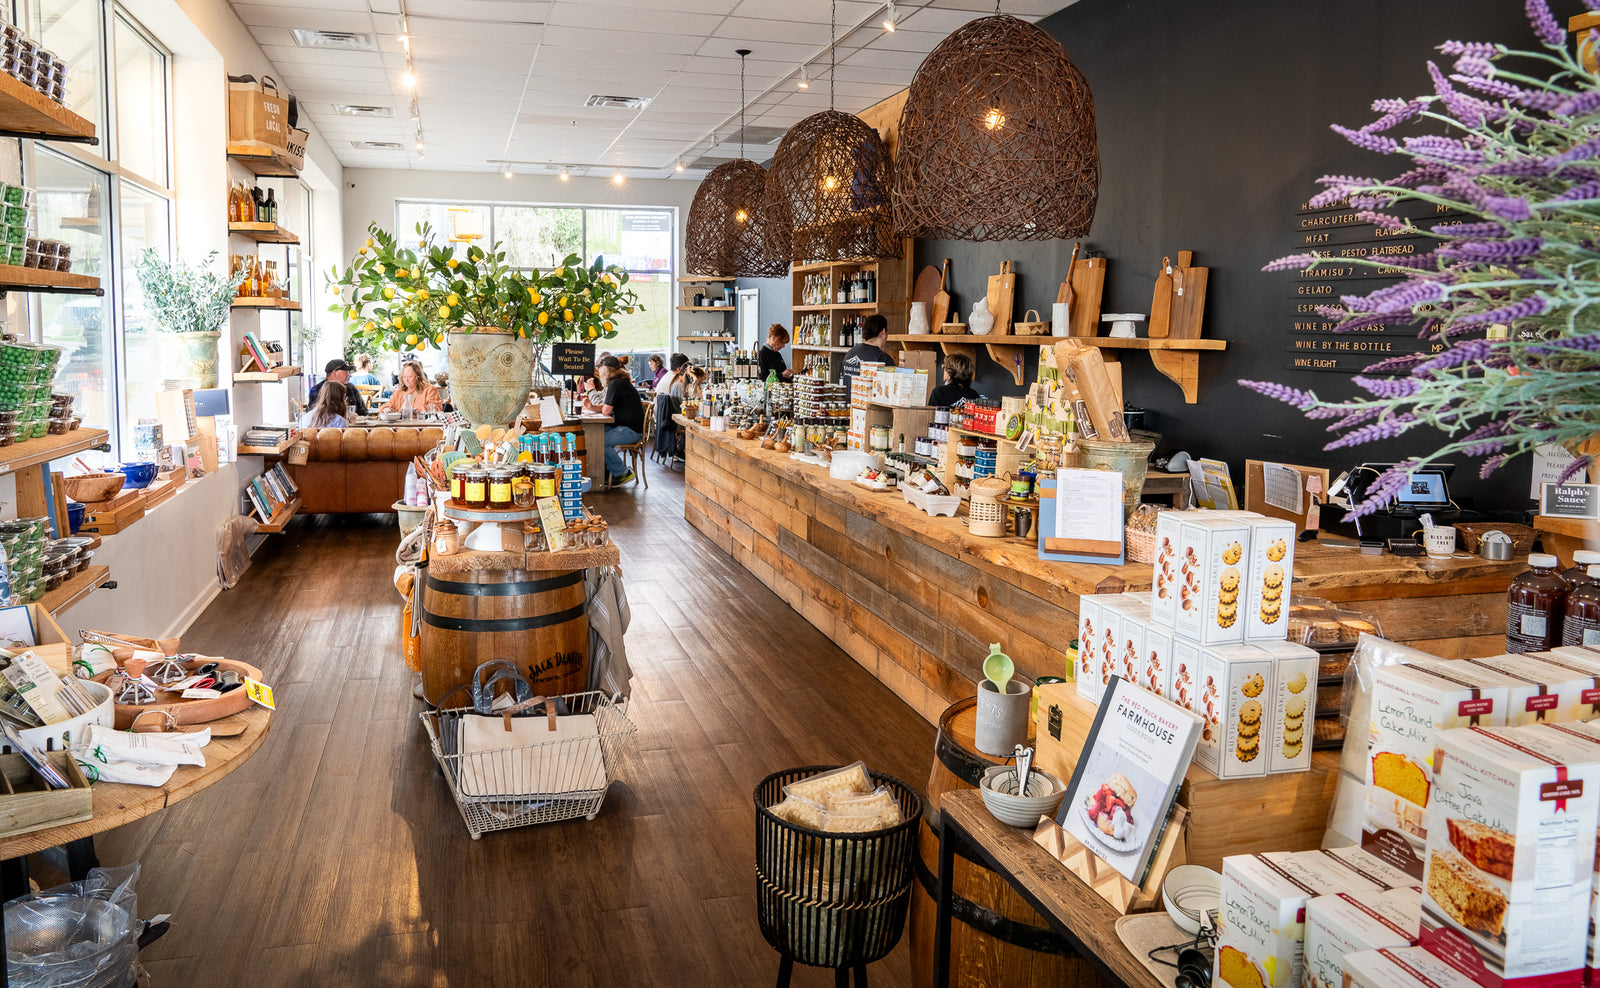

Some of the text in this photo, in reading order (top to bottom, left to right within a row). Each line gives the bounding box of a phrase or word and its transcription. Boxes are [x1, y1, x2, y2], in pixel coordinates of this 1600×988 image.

[263, 102, 280, 115] FRESH
[266, 120, 281, 133] LOCAL
[1342, 248, 1367, 257] PESTO
[1372, 245, 1414, 255] FLATBREAD
[1300, 269, 1344, 277] TIRAMISU
[1298, 286, 1332, 294] GELATO
[1296, 341, 1317, 349] WINE
[1335, 342, 1350, 350] THE
[1353, 343, 1392, 351] BOTTLE
[1294, 358, 1312, 367] WINE
[1555, 487, 1590, 497] Ralph's
[1557, 495, 1586, 503] Sauce
[528, 657, 553, 680] JACK
[1376, 679, 1440, 706] STONEWALL KITCHEN
[1378, 699, 1432, 729] Lemon Pound
[1117, 704, 1175, 745] FARMHOUSE
[1158, 717, 1179, 731] BAKERY
[1381, 716, 1427, 743] Cake Mix
[1480, 769, 1516, 788] KITCHEN
[1225, 891, 1270, 933] Lemon Pound
[1227, 909, 1265, 946] Cake Mix
[1316, 943, 1343, 976] Cinna
